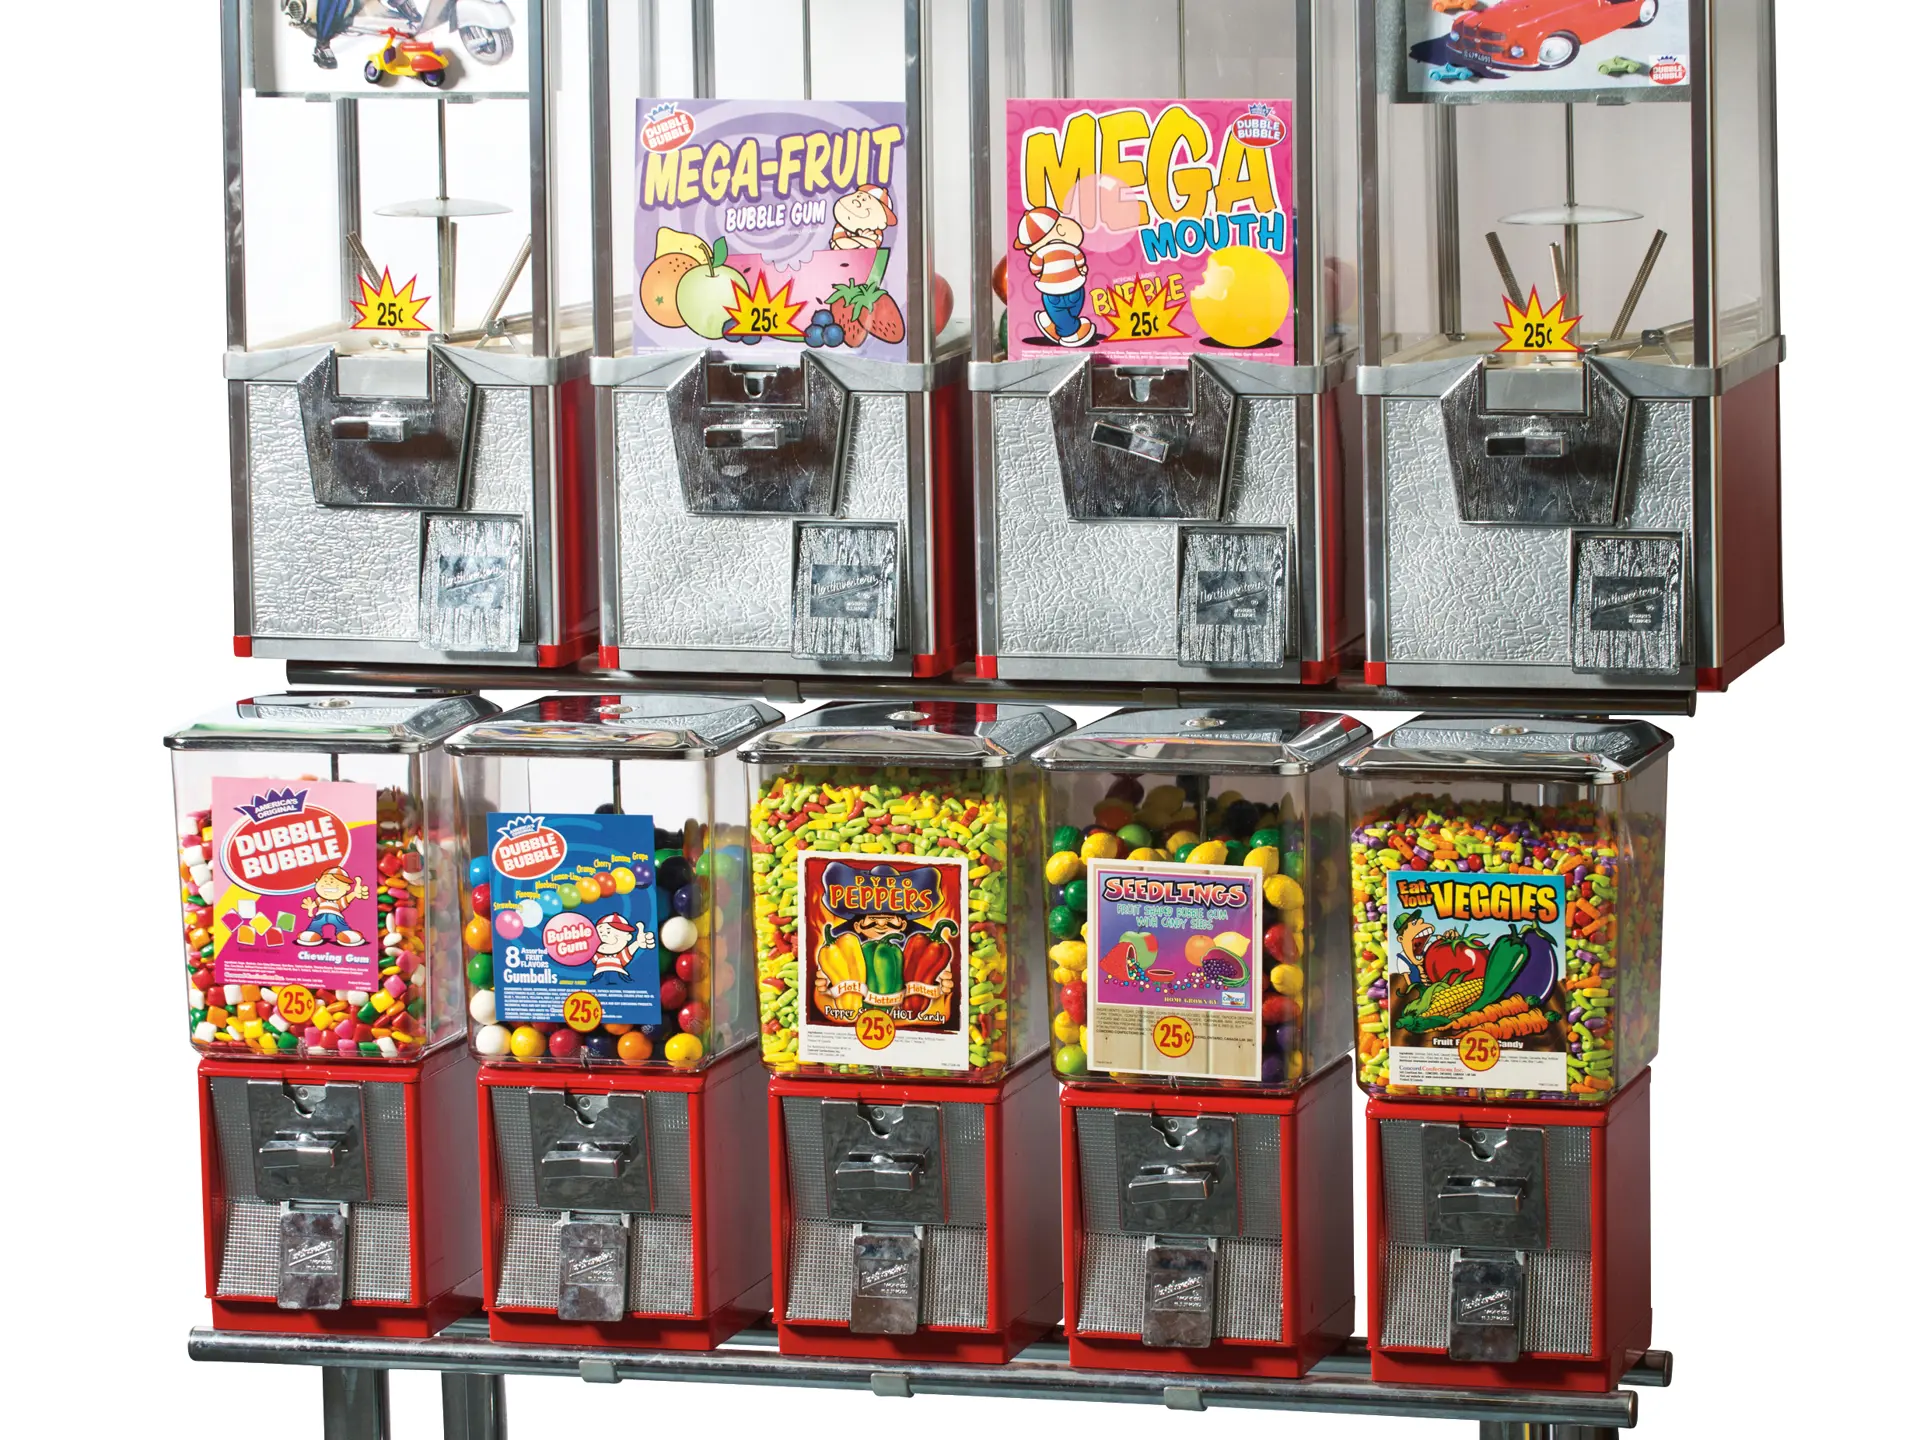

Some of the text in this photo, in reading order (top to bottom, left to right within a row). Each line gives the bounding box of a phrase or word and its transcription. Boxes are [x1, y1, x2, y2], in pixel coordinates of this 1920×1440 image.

[645, 113, 688, 140] DUBBLE
[1236, 118, 1281, 131] DUBBLE
[648, 123, 692, 149] BUBBLE
[1237, 128, 1281, 141] BUBBLE
[642, 125, 903, 208] MEGA-FRUIT
[1025, 105, 1278, 232] MEGA
[726, 199, 828, 232] BUBBLE GUM
[1141, 211, 1285, 263] MOUTH
[376, 302, 405, 326] 25¢
[751, 307, 778, 332] 25¢
[1130, 311, 1159, 336] 25¢
[1523, 322, 1553, 348] 25¢
[254, 798, 299, 814] AMERICA'S
[256, 804, 298, 820] ORIGINAL
[234, 816, 337, 858] DUBBLE
[498, 833, 557, 860] DUBBLE
[241, 838, 343, 879] BUBBLE
[503, 845, 561, 872] BUBBLE
[593, 858, 612, 870] Cherry
[632, 851, 649, 862] Grape
[855, 875, 913, 888] PYRO
[1398, 879, 1427, 895] Eat
[829, 884, 934, 913] PEPPERS
[1103, 878, 1248, 908] SEEDLINGS
[1399, 893, 1433, 908] Your
[1430, 881, 1559, 923] VEGGIES
[1116, 903, 1142, 916] FRUIT
[1206, 909, 1229, 920] GUM
[1135, 916, 1214, 931] WITH CANDY SEEDS
[546, 923, 592, 944] Bubble
[297, 950, 370, 965] Chewing Gum
[505, 945, 521, 968] 8
[521, 947, 548, 955] Assorted
[557, 940, 588, 957] Gum
[520, 960, 549, 968] FLAVORS
[503, 968, 558, 984] Gumballs
[837, 981, 861, 994] Hot!
[907, 983, 939, 999] Hottest!
[283, 991, 312, 1016] 25¢
[868, 992, 903, 1005] Hotter!
[1184, 997, 1208, 1005] GROWN
[569, 998, 600, 1023] 25¢
[825, 1005, 854, 1020] Pepper
[893, 1009, 913, 1020] HOT
[917, 1011, 945, 1025] Candy
[862, 1017, 893, 1041] 25¢
[1159, 1023, 1191, 1049] 25¢
[1433, 1038, 1454, 1046] Fruit
[1464, 1037, 1497, 1063] 25¢
[1498, 1040, 1524, 1049] Candy
